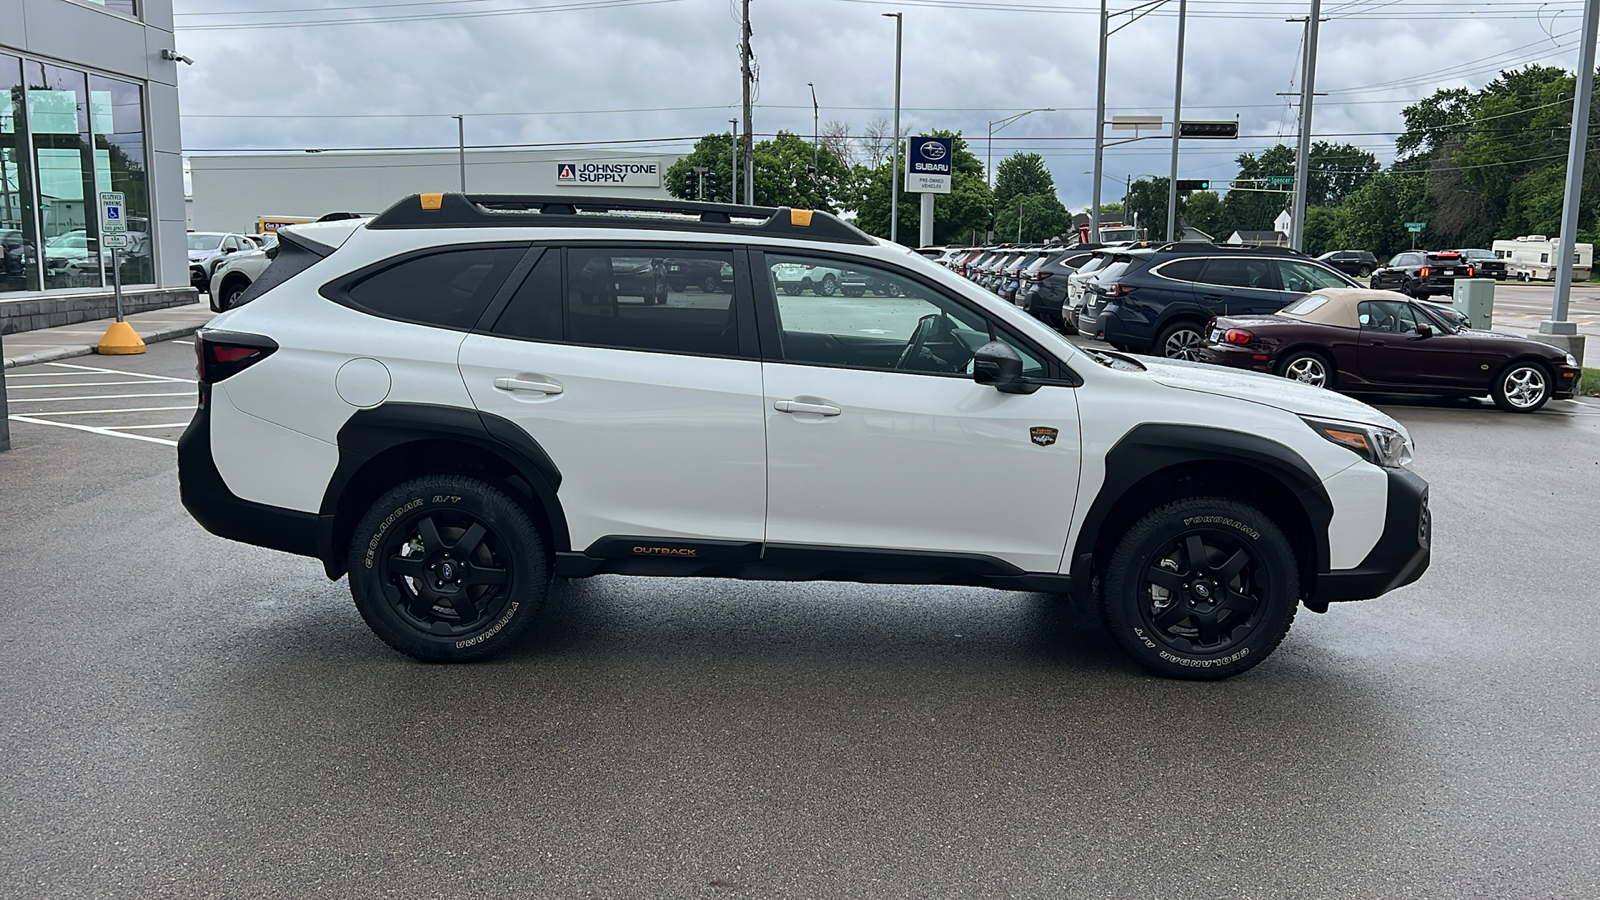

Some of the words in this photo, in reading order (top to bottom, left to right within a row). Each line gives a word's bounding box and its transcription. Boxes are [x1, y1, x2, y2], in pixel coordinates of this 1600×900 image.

[578, 164, 656, 174] JOHNSTONE
[915, 162, 948, 172] SUBARU
[579, 174, 627, 182] SUPPLY
[365, 498, 424, 569] GEOLANDAR
[1184, 516, 1260, 540] YOKOHAMA
[633, 546, 696, 556] OUTBACK
[456, 601, 520, 648] YOKOHAMA
[1134, 628, 1156, 648] A/T
[1160, 648, 1250, 668] GEOLANDAR
